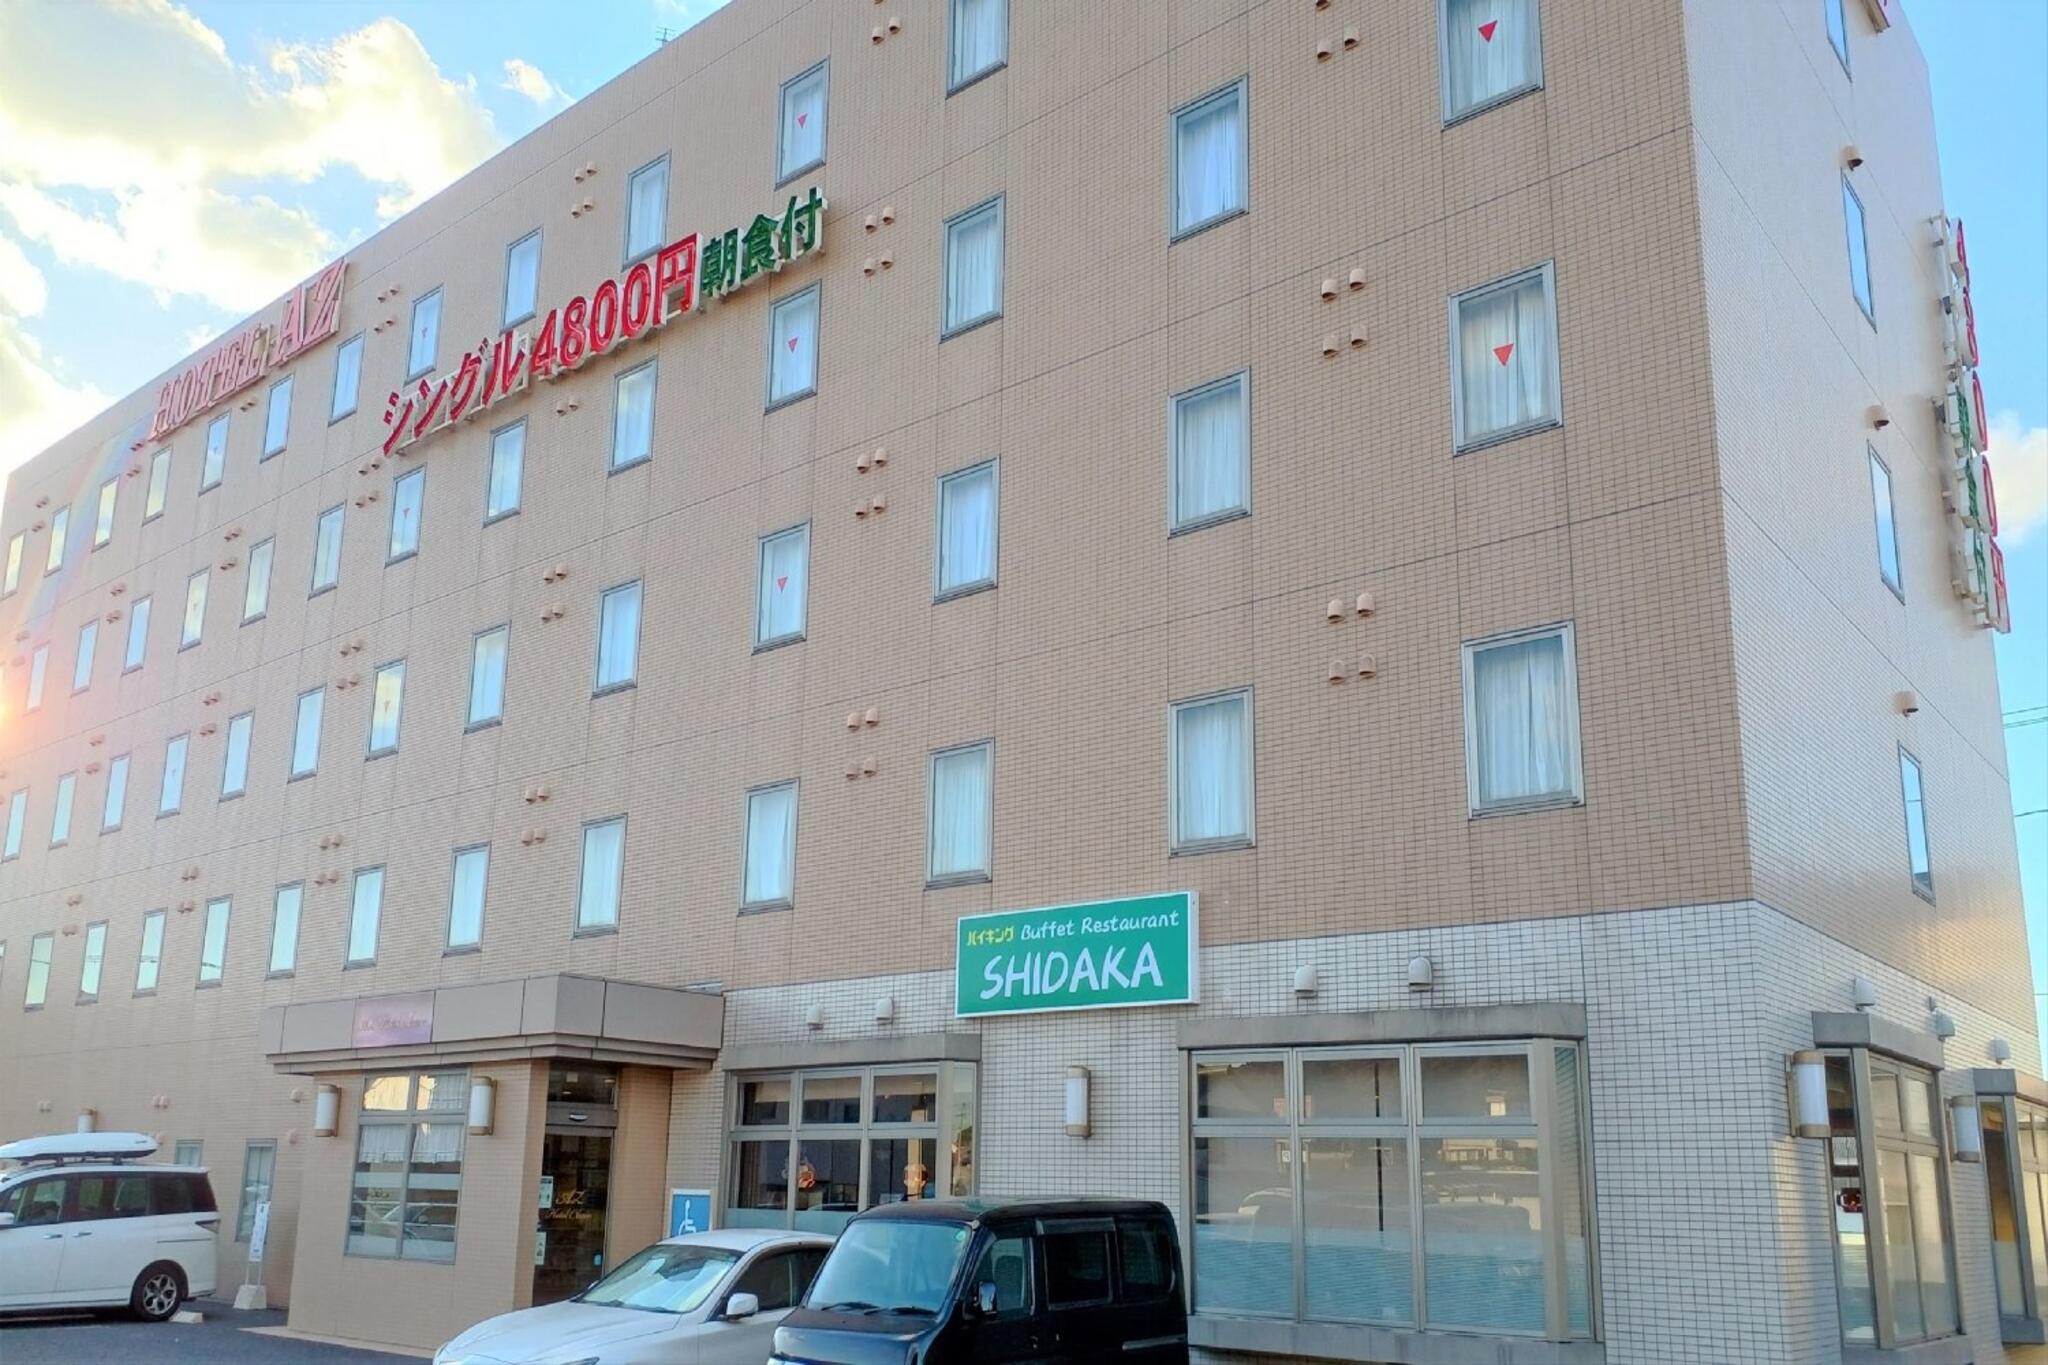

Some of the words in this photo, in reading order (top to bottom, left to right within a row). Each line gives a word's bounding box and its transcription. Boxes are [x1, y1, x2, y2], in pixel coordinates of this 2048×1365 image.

[149, 322, 267, 441] HOTEL
[268, 256, 347, 368] AZ
[1020, 920, 1075, 941] Buffet
[1080, 909, 1180, 935] Restaurant
[980, 941, 1164, 1000] SHIDAKA
